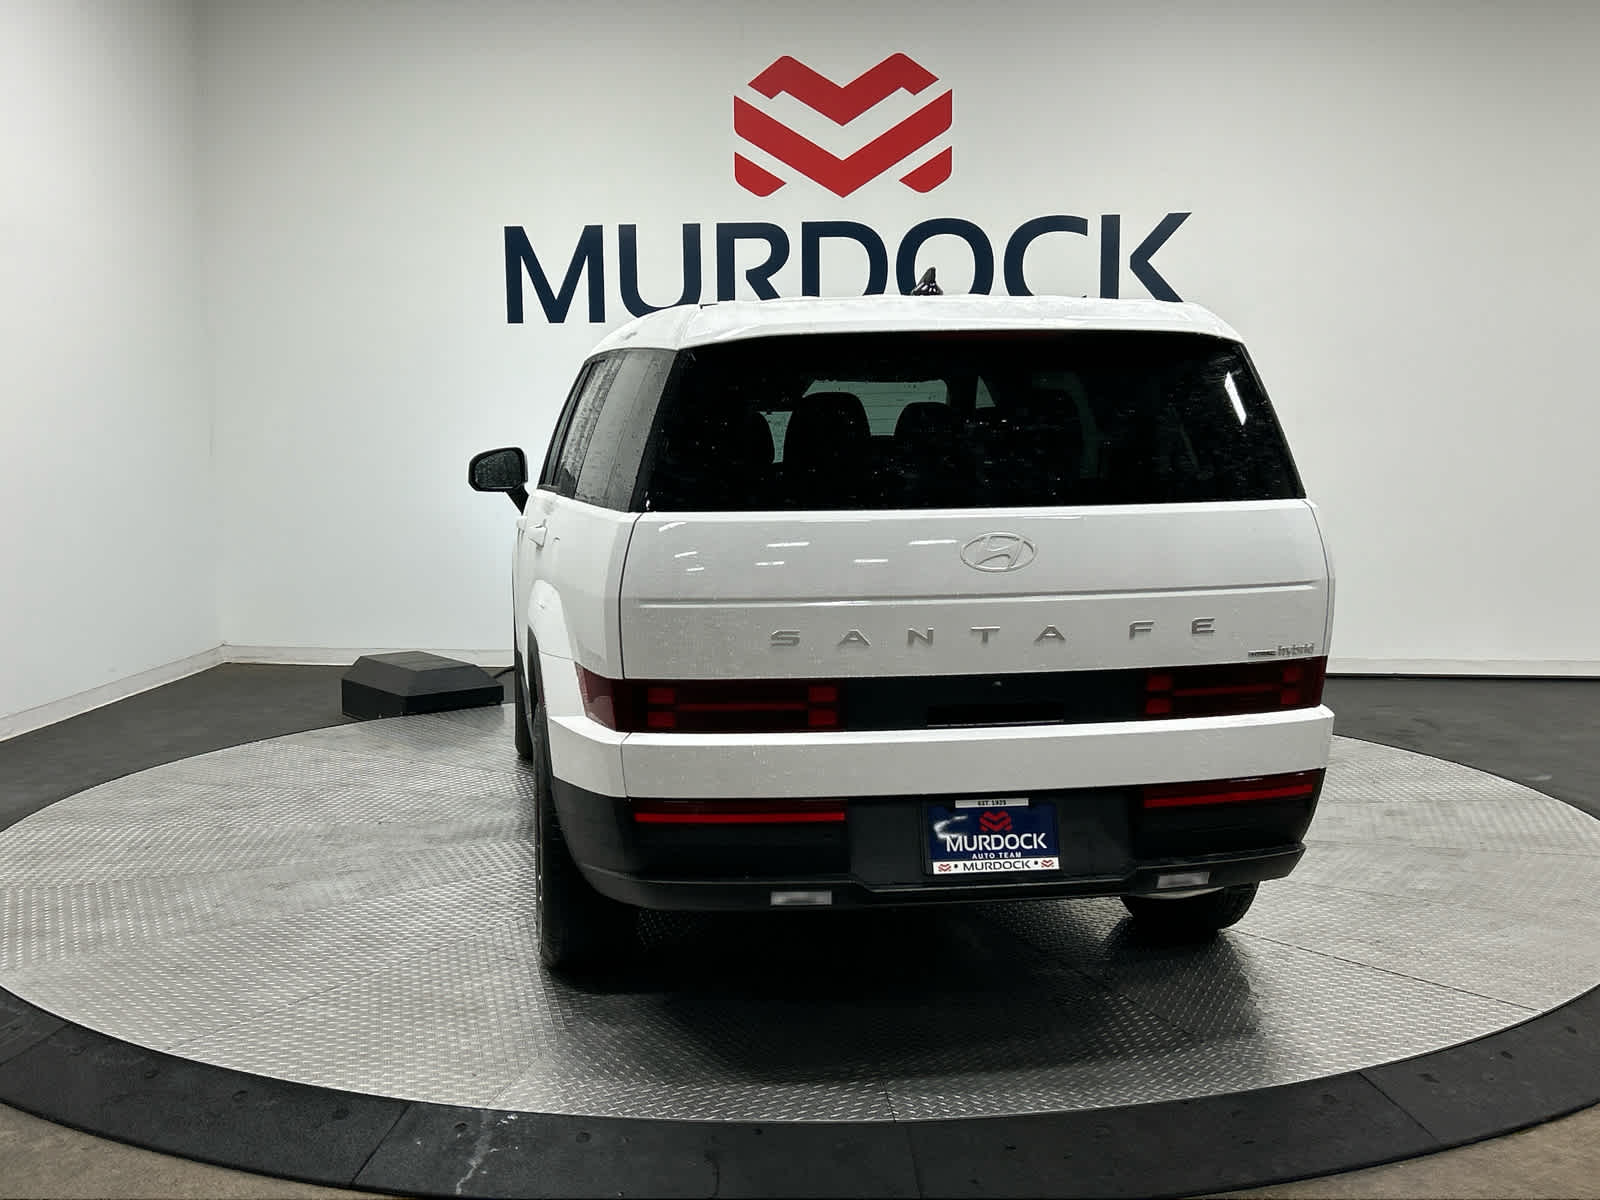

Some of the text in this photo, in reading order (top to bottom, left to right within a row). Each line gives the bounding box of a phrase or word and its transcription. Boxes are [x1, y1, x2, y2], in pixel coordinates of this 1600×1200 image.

[504, 212, 1191, 323] MURDOCK
[769, 616, 1217, 647] SANTA FE
[946, 833, 1048, 852] MURDOCK
[963, 860, 1032, 871] MURDOCK
